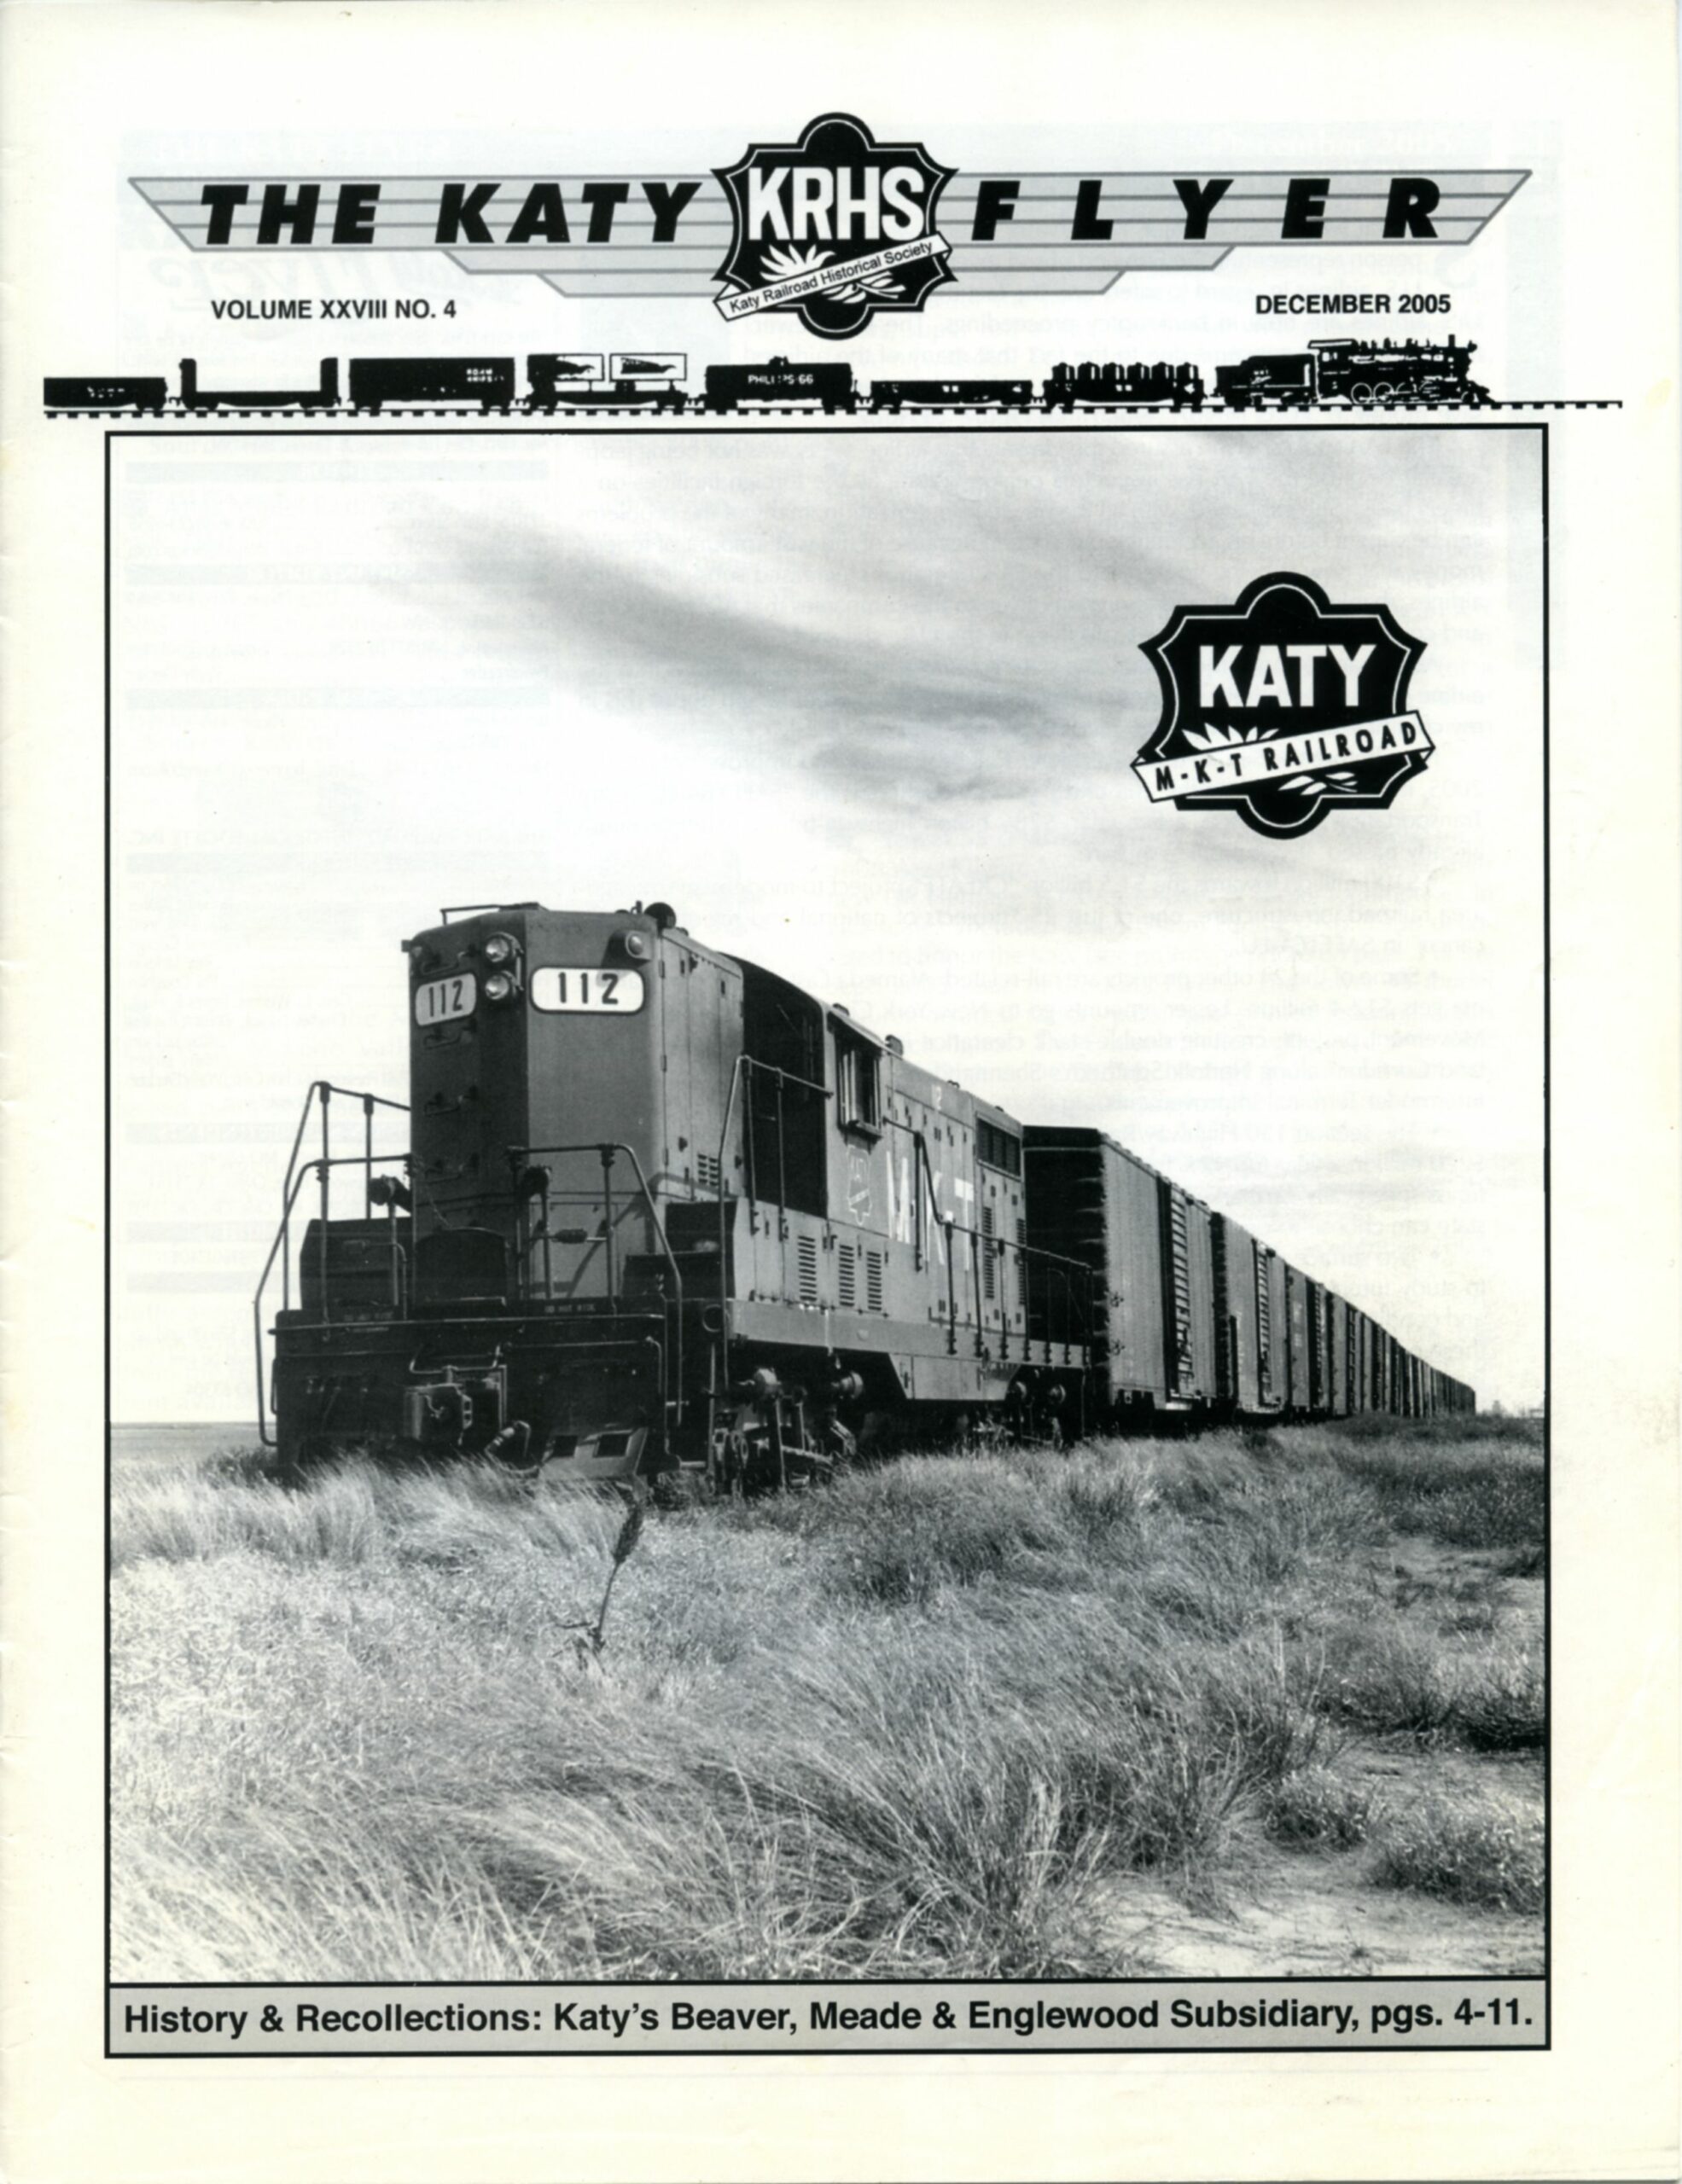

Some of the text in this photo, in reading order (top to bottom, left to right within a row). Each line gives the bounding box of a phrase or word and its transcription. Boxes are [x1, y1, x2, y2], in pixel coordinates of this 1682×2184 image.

[201, 177, 1441, 244] THE KATY FLYER
[748, 166, 925, 241] KRHS
[729, 241, 933, 313] Katy Railroad Historical Society
[211, 299, 457, 319] VOLUME XXVIII NO. 4
[1256, 293, 1451, 315] DECEMBER 2005
[1200, 644, 1376, 707] KATY
[1155, 720, 1417, 792] M-K-T RAILROAD
[428, 979, 463, 1018] 112
[558, 971, 619, 1005] 112
[125, 1997, 1533, 2040] History & Recollections: Katy's Beaver, Meade & Englewood Subsidiary, pgs. 4-11.
